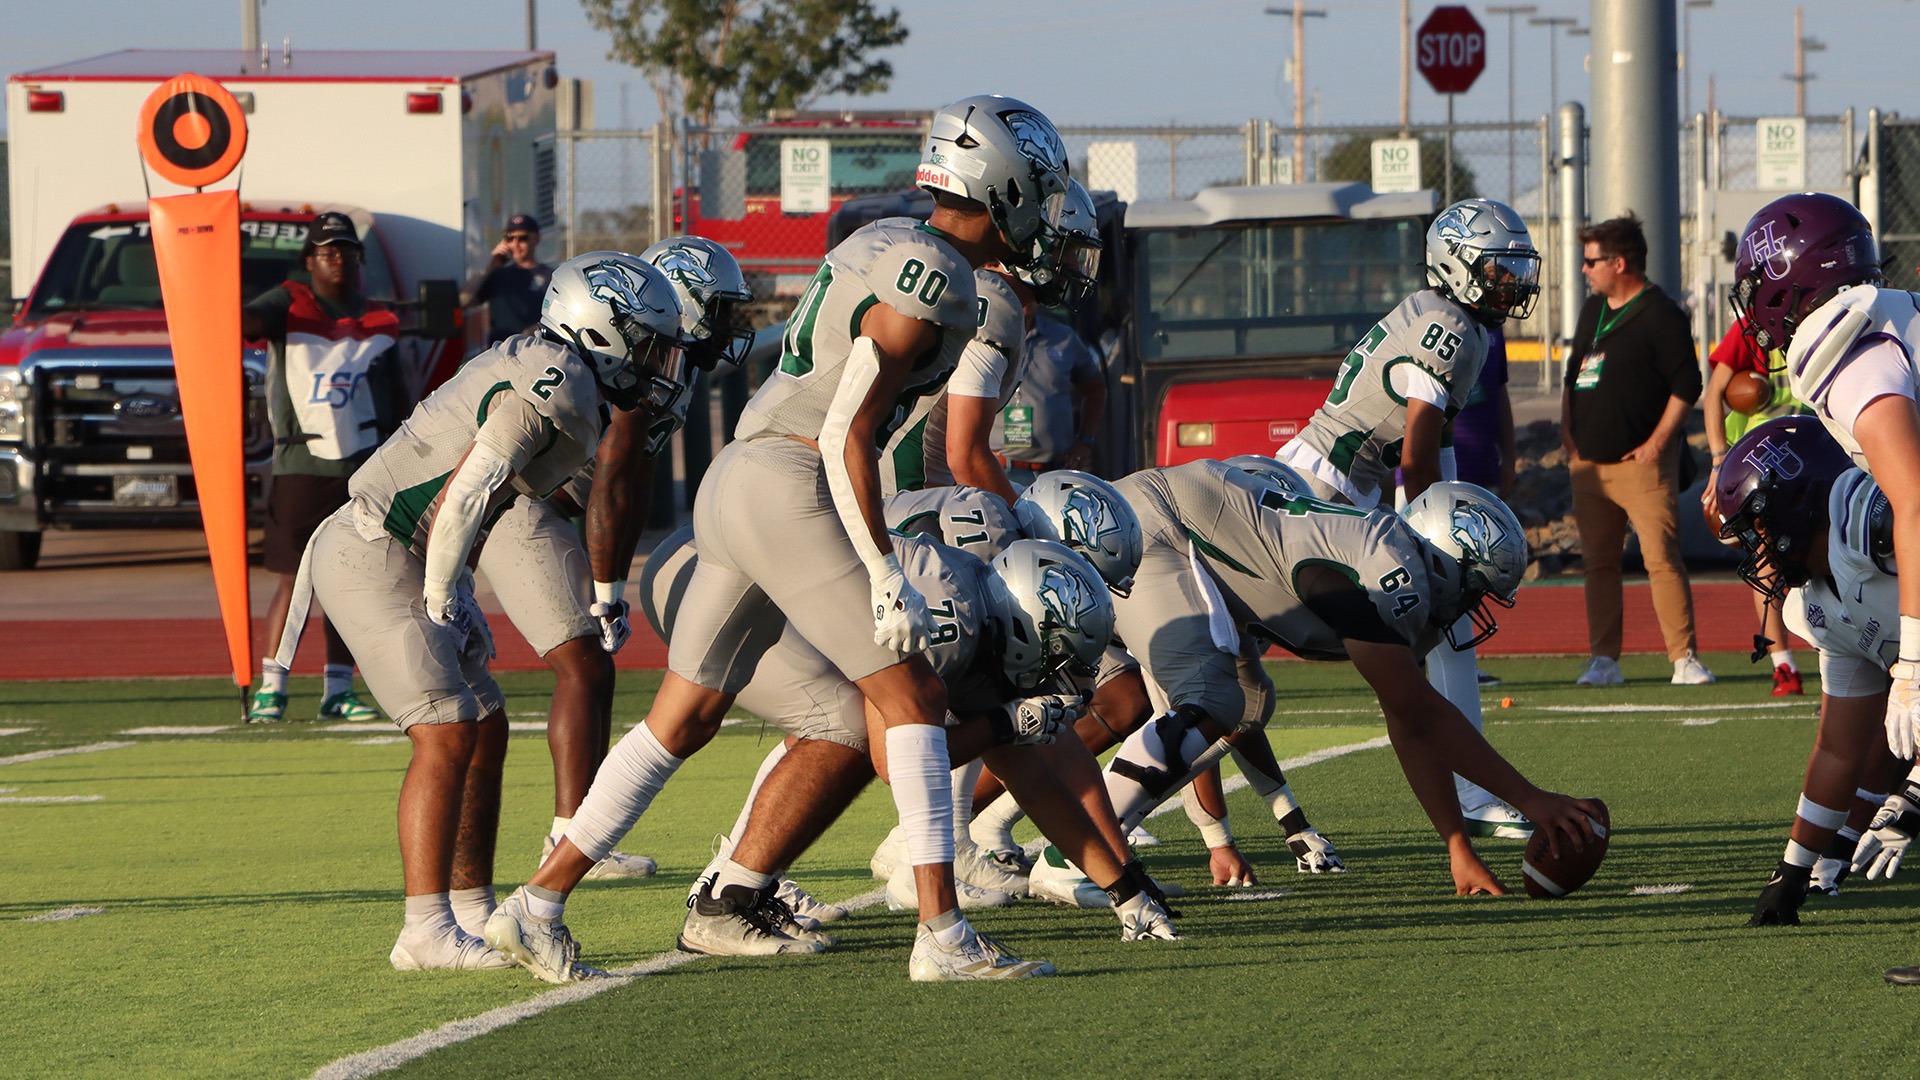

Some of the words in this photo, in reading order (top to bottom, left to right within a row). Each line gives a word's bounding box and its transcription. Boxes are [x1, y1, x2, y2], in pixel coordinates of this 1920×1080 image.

[1421, 32, 1482, 68] STOP
[1767, 125, 1795, 140] NO
[791, 163, 819, 172] EXIT
[792, 148, 820, 162] NO
[1382, 147, 1409, 162] NO
[1382, 163, 1409, 173] EXIT
[1745, 220, 1792, 281] HU
[895, 257, 950, 308] 80
[1419, 321, 1464, 363] 85
[529, 365, 567, 404] 2
[1271, 427, 1295, 436] TORO
[1742, 436, 1804, 481] HU
[950, 508, 990, 549] 71
[1378, 565, 1422, 620] 64
